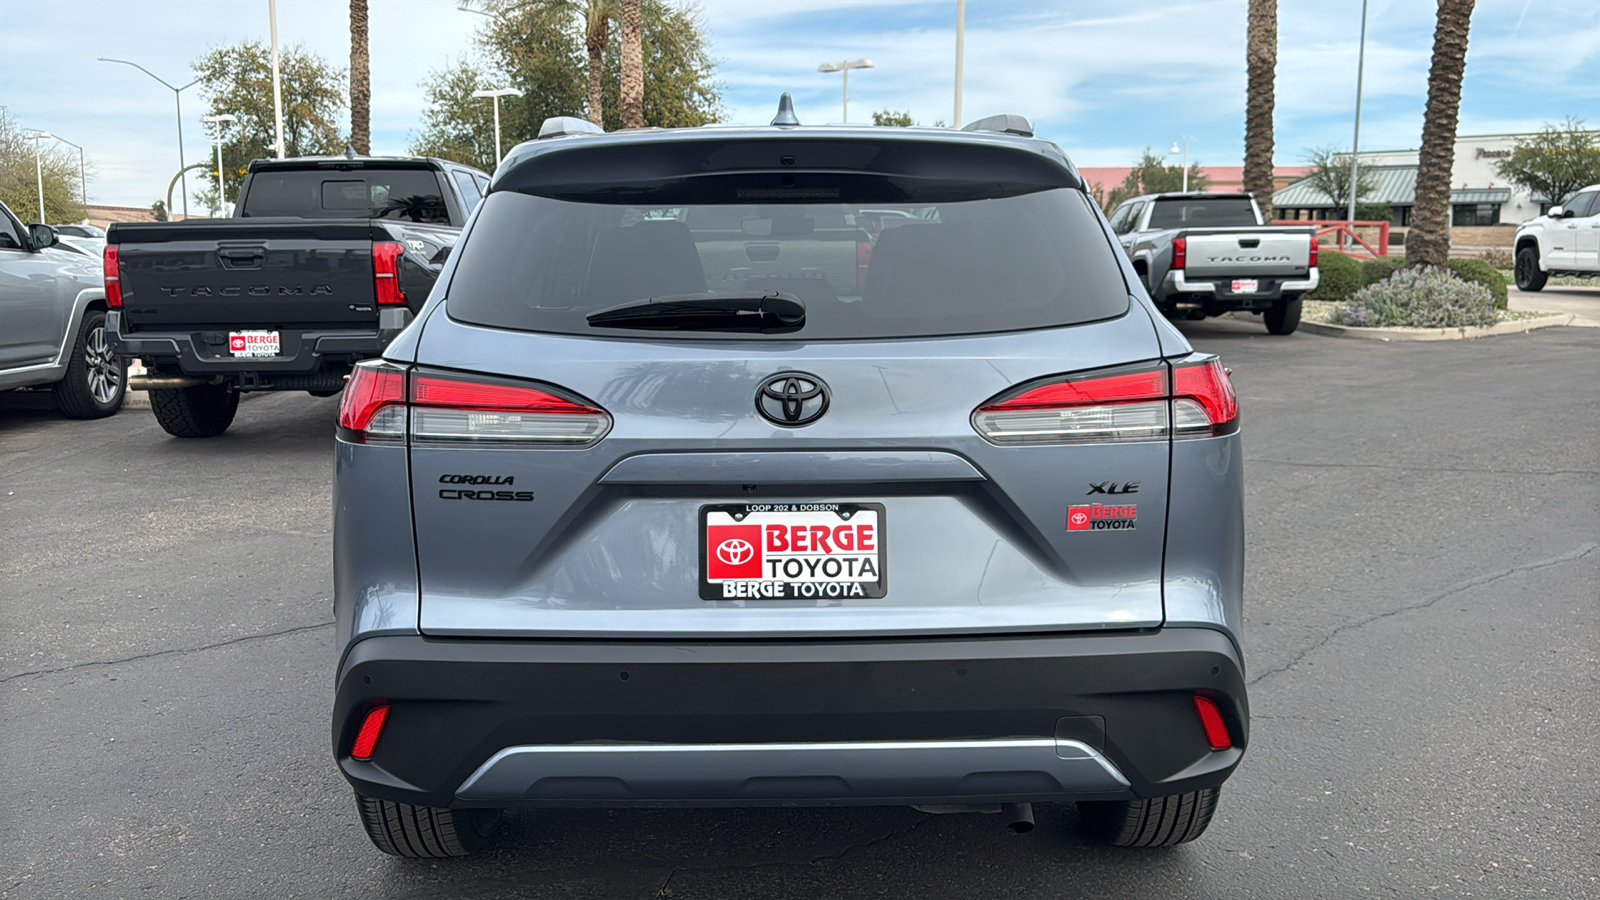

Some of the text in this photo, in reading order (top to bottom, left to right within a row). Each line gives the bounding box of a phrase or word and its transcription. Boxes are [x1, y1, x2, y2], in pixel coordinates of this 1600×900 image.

[405, 240, 424, 250] TRD
[161, 285, 334, 297] TACOMA
[247, 336, 278, 344] BERGE
[439, 474, 515, 485] COROLLA
[1086, 481, 1141, 496] XLE
[439, 489, 534, 501] CROSS
[746, 504, 771, 512] LOOP
[800, 503, 839, 511] DOBSON
[1091, 504, 1137, 519] BERGE
[1090, 520, 1135, 529] TOYOTA
[765, 524, 875, 555] BERGE
[766, 557, 878, 578] TOYOTA
[722, 580, 864, 598] BERGE TOYOTA
